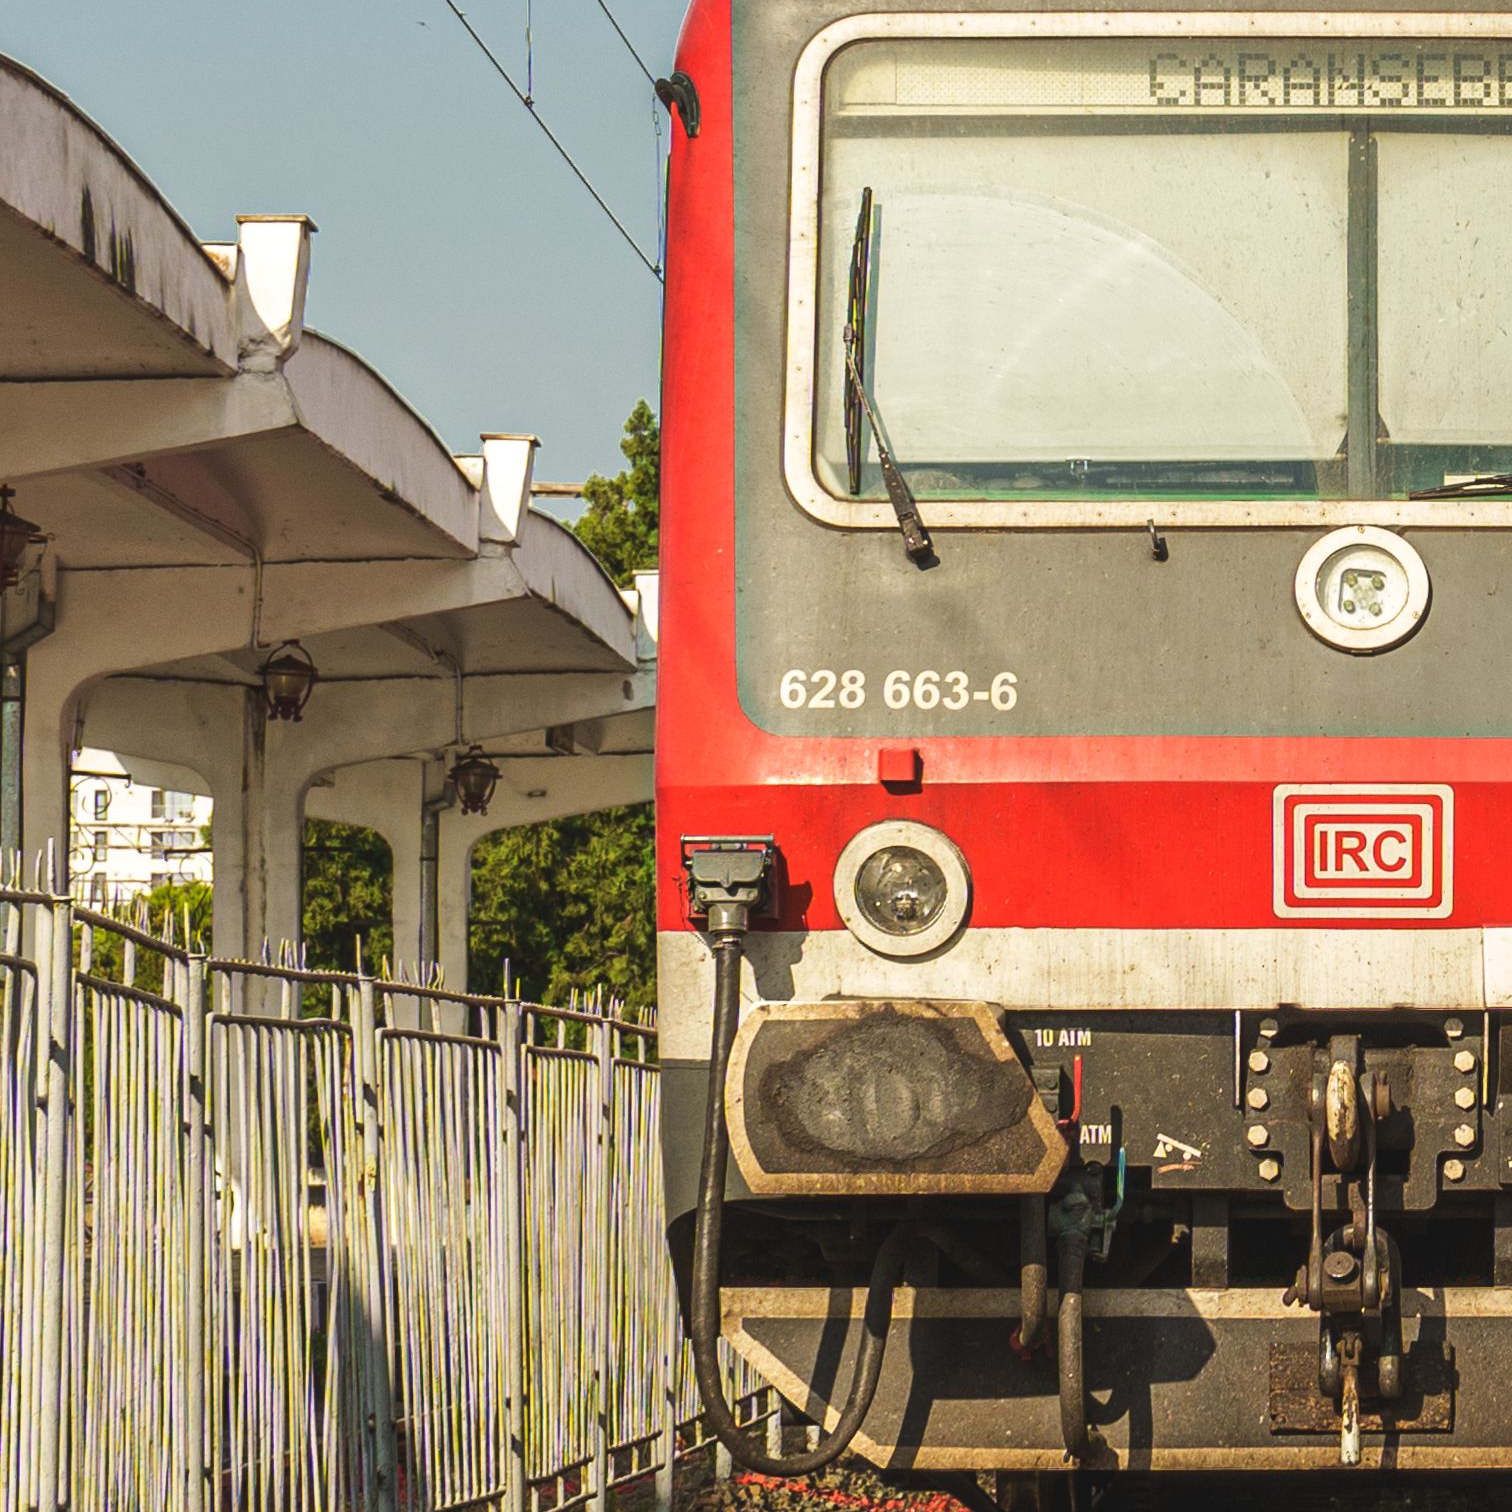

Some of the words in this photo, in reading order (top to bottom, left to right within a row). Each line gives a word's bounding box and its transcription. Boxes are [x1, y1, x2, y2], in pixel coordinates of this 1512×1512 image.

[779, 669, 866, 709] 628
[883, 670, 1018, 711] 663-6
[1319, 830, 1407, 872] IRC
[1079, 1124, 1112, 1145] ATM
